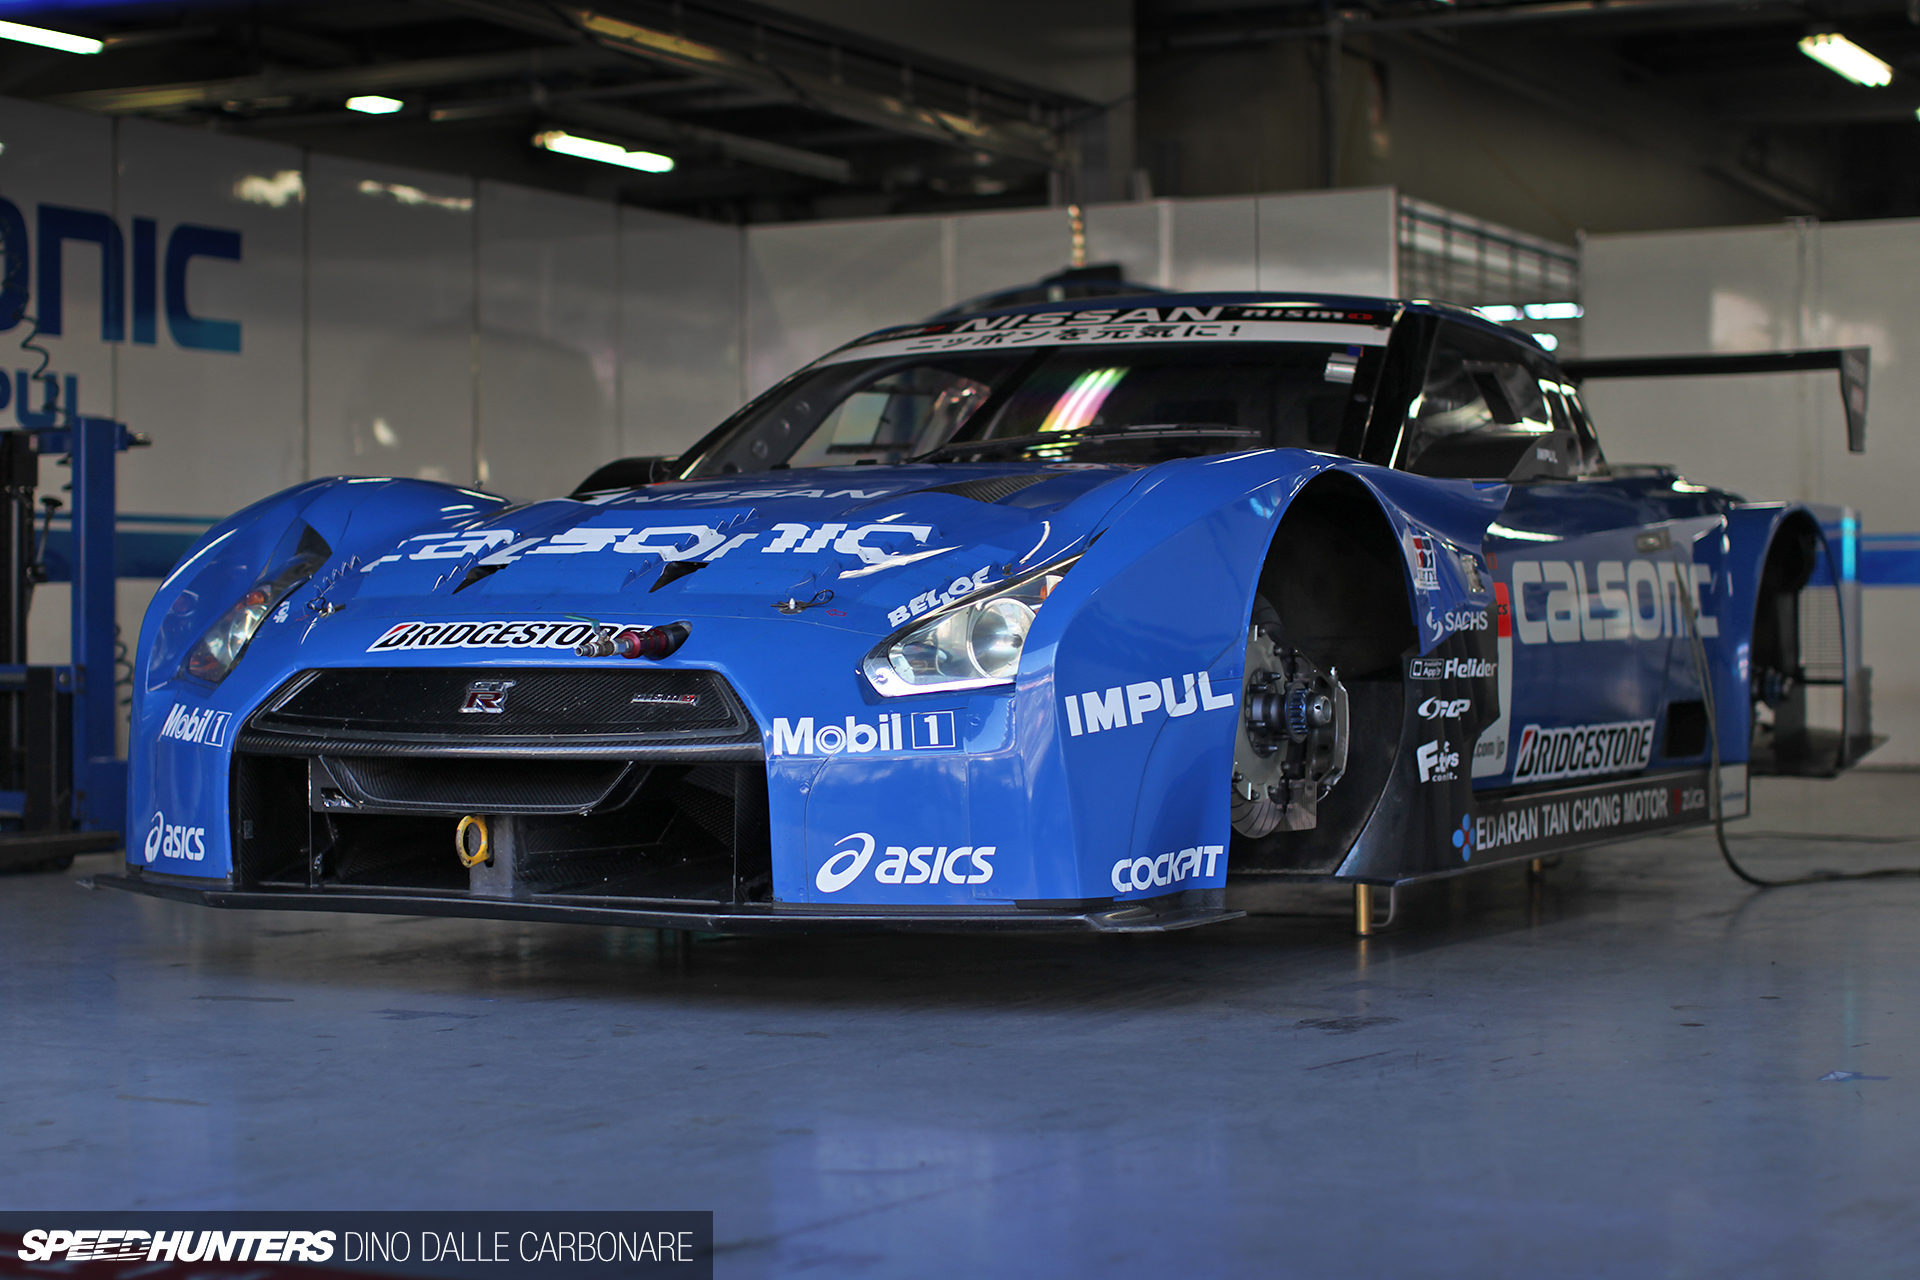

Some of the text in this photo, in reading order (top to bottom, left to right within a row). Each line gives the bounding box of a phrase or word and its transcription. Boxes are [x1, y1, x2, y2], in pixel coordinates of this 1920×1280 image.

[952, 306, 1225, 333] NISSAN
[1242, 308, 1373, 320] nismo
[611, 488, 891, 506] NISSAN
[1445, 610, 1489, 632] SACHS
[162, 703, 214, 744] Mobil
[1065, 671, 1234, 736] IMPUL
[773, 713, 902, 755] Mobil
[1515, 723, 1653, 778] BRIDGESTONE
[1476, 814, 1538, 851] EDARAN
[1542, 806, 1570, 835] TAN
[1573, 797, 1621, 832] CHONG
[1623, 788, 1669, 824] MOTOR
[1111, 845, 1224, 893] COCKPIT
